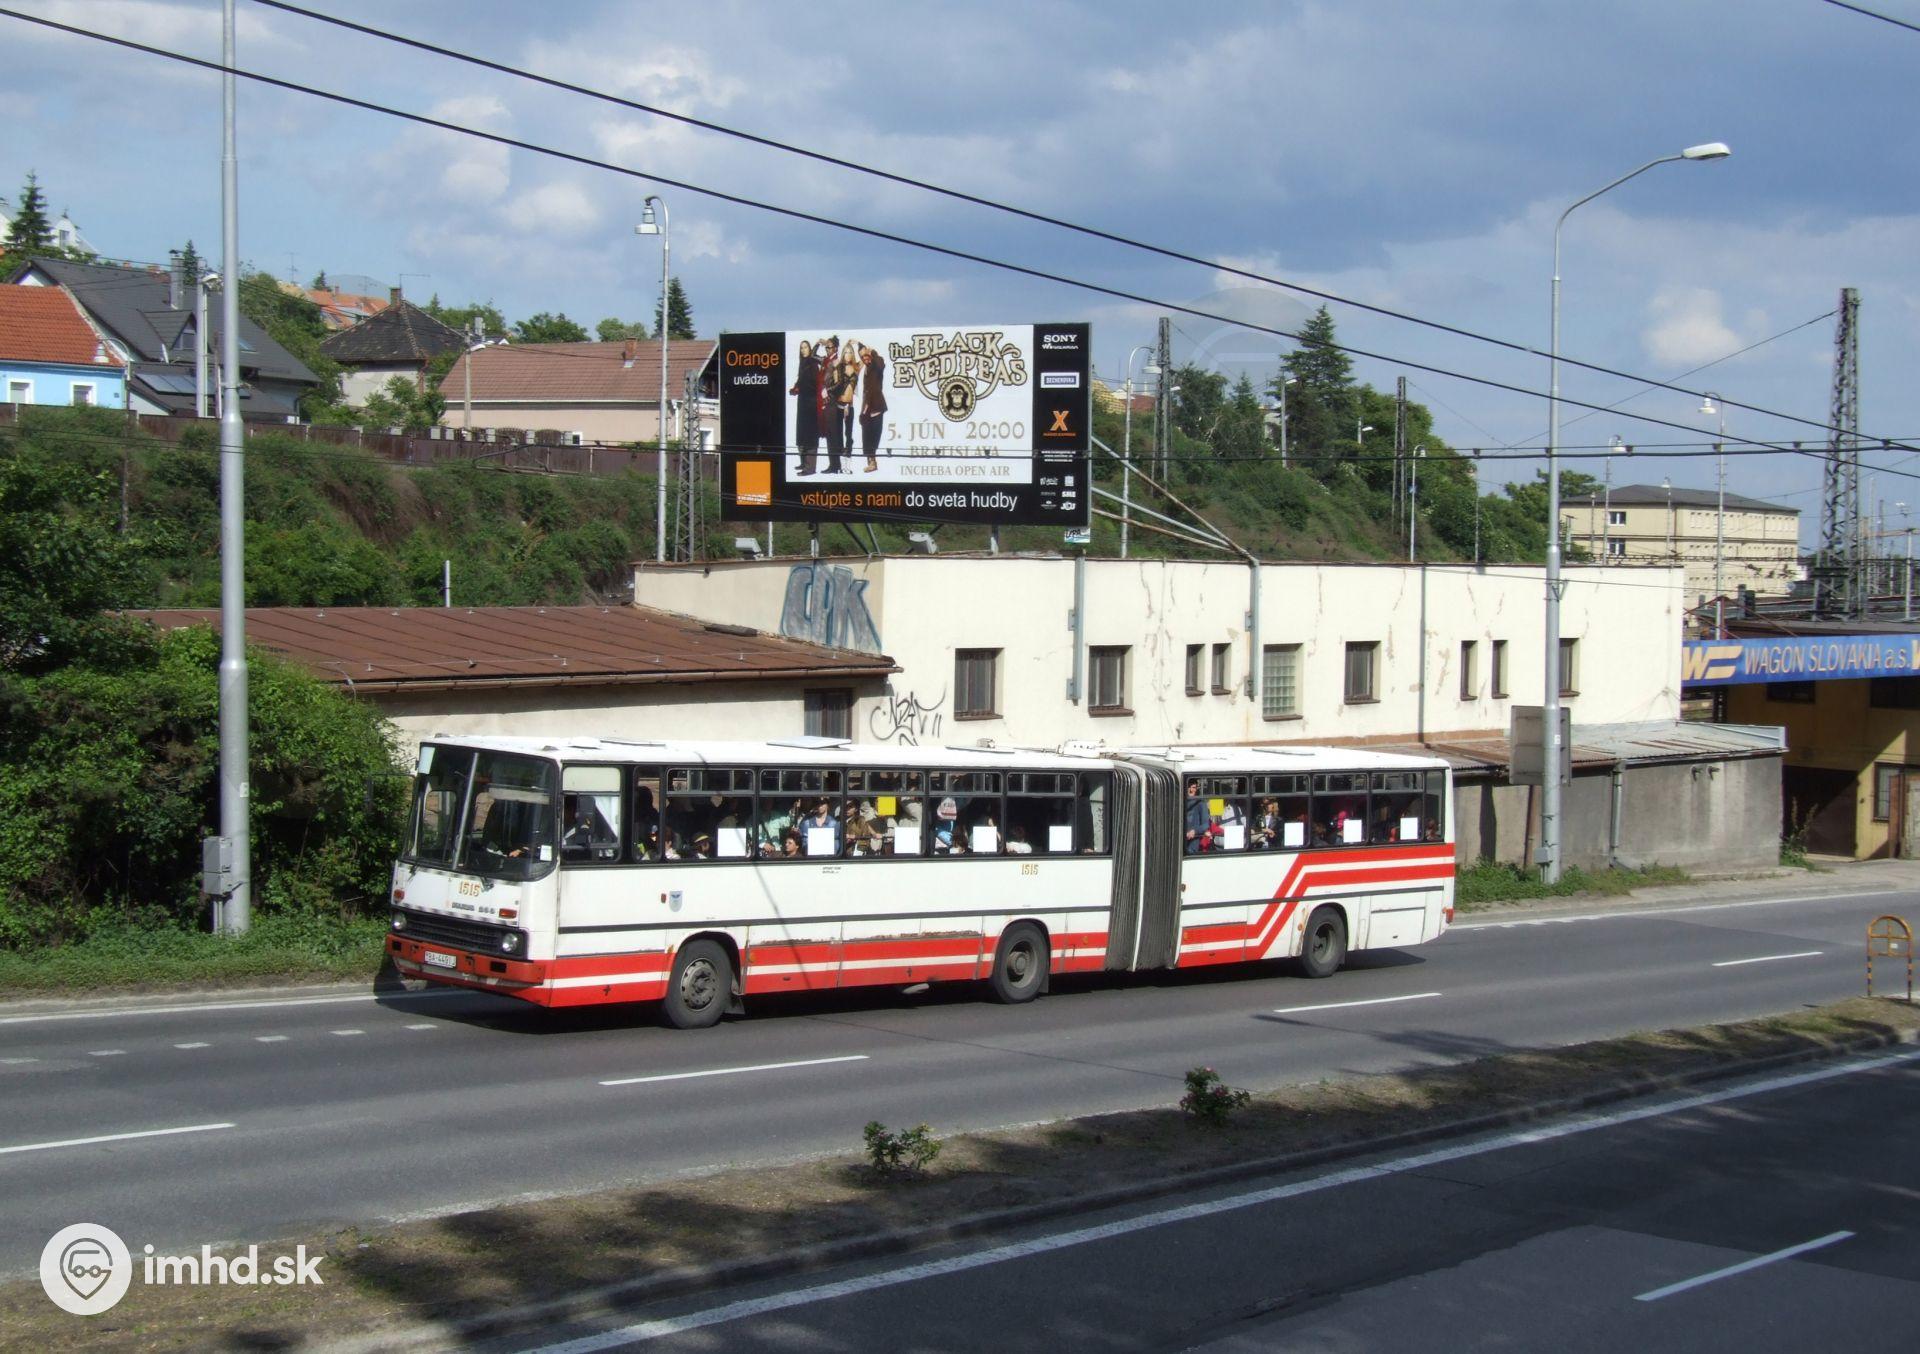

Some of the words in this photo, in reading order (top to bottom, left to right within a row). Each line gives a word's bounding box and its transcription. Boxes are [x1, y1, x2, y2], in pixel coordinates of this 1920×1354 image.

[889, 342, 913, 361] the
[911, 332, 1004, 360] BLACK
[1043, 334, 1077, 343] SONY
[726, 350, 780, 369] Orange
[733, 373, 769, 385] uvádza
[893, 352, 957, 389] EYED
[959, 351, 1028, 386] PEAS
[887, 422, 902, 441] 5.
[909, 418, 946, 441] JÚN
[966, 421, 1025, 440] 20:00
[900, 465, 952, 476] INCHEBA
[955, 465, 986, 476] OPEN
[990, 465, 1010, 476] AIR
[801, 490, 850, 509] vstúpte
[855, 494, 863, 506] s
[867, 491, 901, 507] nami
[905, 491, 924, 507] do
[928, 492, 967, 507] sveta
[971, 491, 1018, 512] hudby
[1744, 646, 1805, 675] WAGON
[1808, 642, 1881, 673] SLOVAKIA
[1885, 647, 1910, 669] a.s.
[1021, 863, 1039, 875] 1515
[458, 880, 481, 897] 1515
